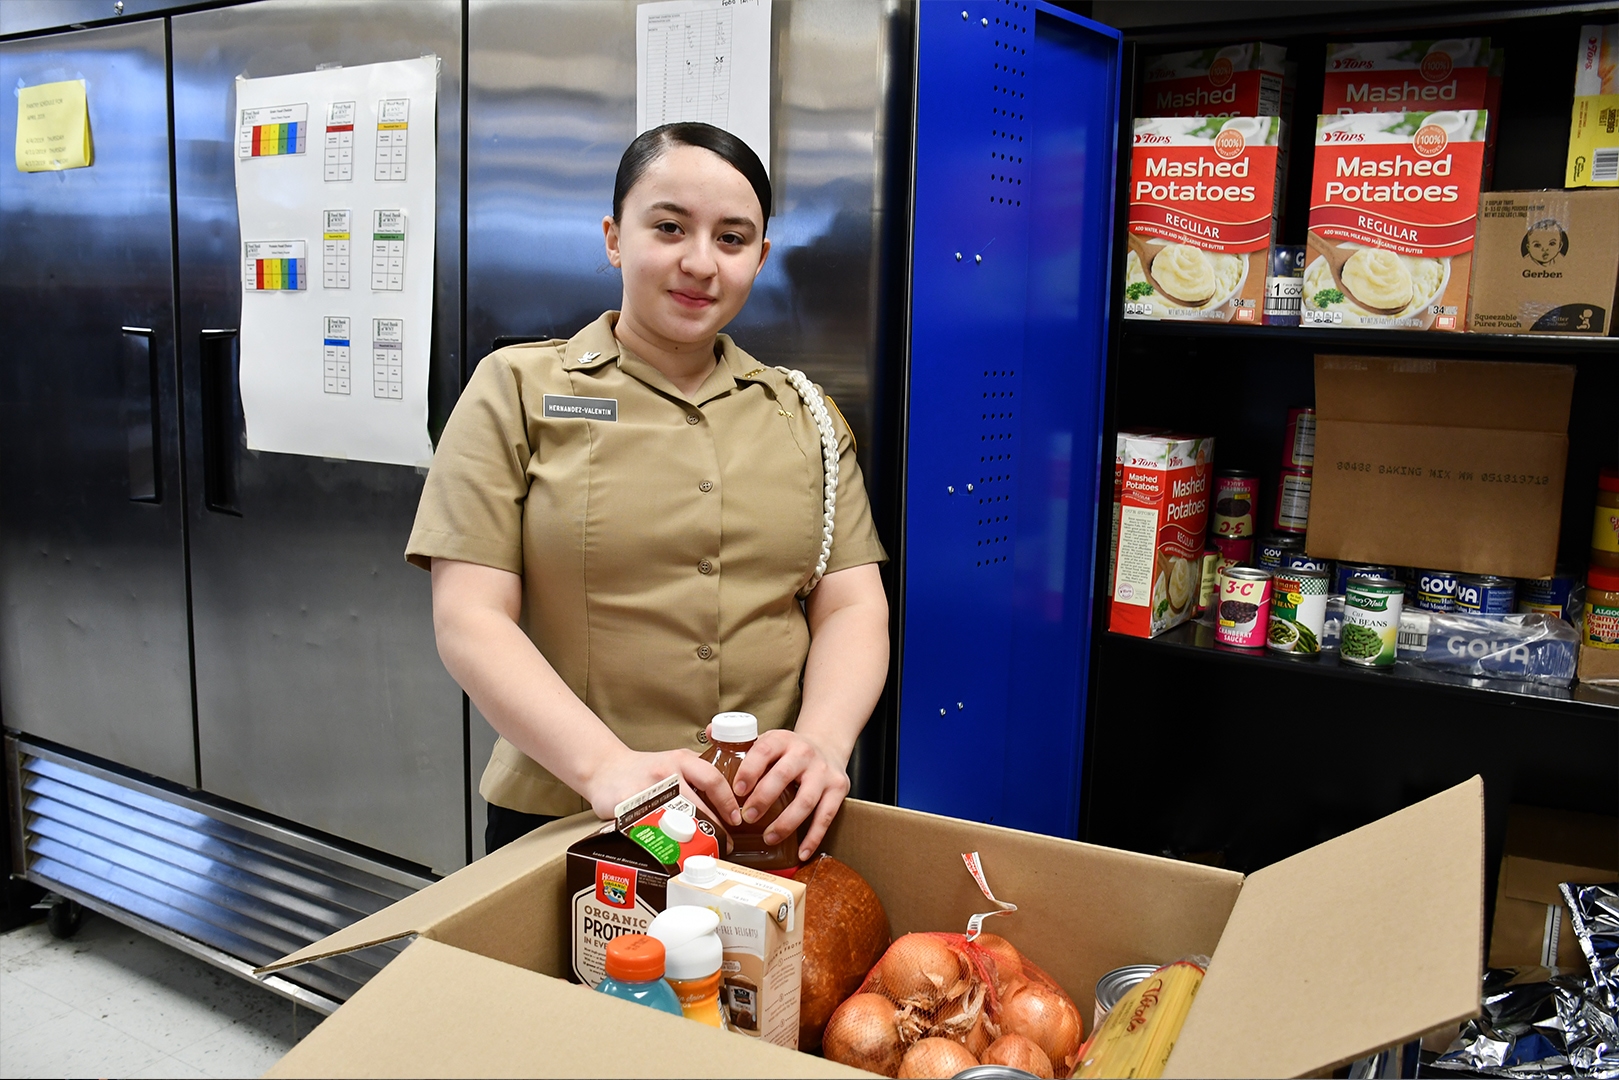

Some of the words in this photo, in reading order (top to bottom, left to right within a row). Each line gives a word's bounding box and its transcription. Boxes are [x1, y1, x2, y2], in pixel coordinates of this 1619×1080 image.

[1343, 58, 1374, 69] TOPS
[1156, 83, 1236, 109] Mashed
[1346, 80, 1458, 103] Mashed
[1143, 133, 1172, 144] TOPS
[1332, 131, 1366, 142] TOPS
[1421, 134, 1441, 145] 100%
[1220, 138, 1239, 148] 100%
[1145, 157, 1249, 178] Mashed
[1336, 154, 1452, 177] Mashed
[1136, 181, 1256, 202] Potatoes
[1325, 181, 1459, 203] Potatoes
[1165, 213, 1220, 240] REGULAR
[1358, 215, 1418, 242] REGULAR
[1371, 238, 1397, 250] MARGARINE
[1284, 287, 1302, 295] GOY
[1433, 306, 1444, 314] 34
[1475, 313, 1517, 322] Squeezable
[548, 404, 612, 416] HERNANDEZ-VALENTIN
[1129, 472, 1158, 484] Mashed
[1378, 464, 1422, 477] BAKING
[1429, 469, 1451, 480] MIX
[1126, 481, 1159, 492] Potatoes
[1172, 474, 1206, 499] Mashed
[1167, 499, 1205, 522] Potatoes
[1220, 521, 1245, 534] 3-C
[1264, 548, 1281, 557] GOY
[1225, 580, 1254, 596] 3-C
[1420, 576, 1457, 594] GOY
[1278, 600, 1295, 609] BEANS
[1359, 618, 1387, 627] BEANS
[1219, 627, 1252, 638] CRANBERRY
[1224, 634, 1243, 643] SAUCE
[1447, 635, 1530, 665] GOYA
[602, 872, 630, 885] HORIZON
[605, 880, 626, 890] ORGANIC
[584, 905, 648, 929] ORGANIC
[584, 936, 592, 945] IN
